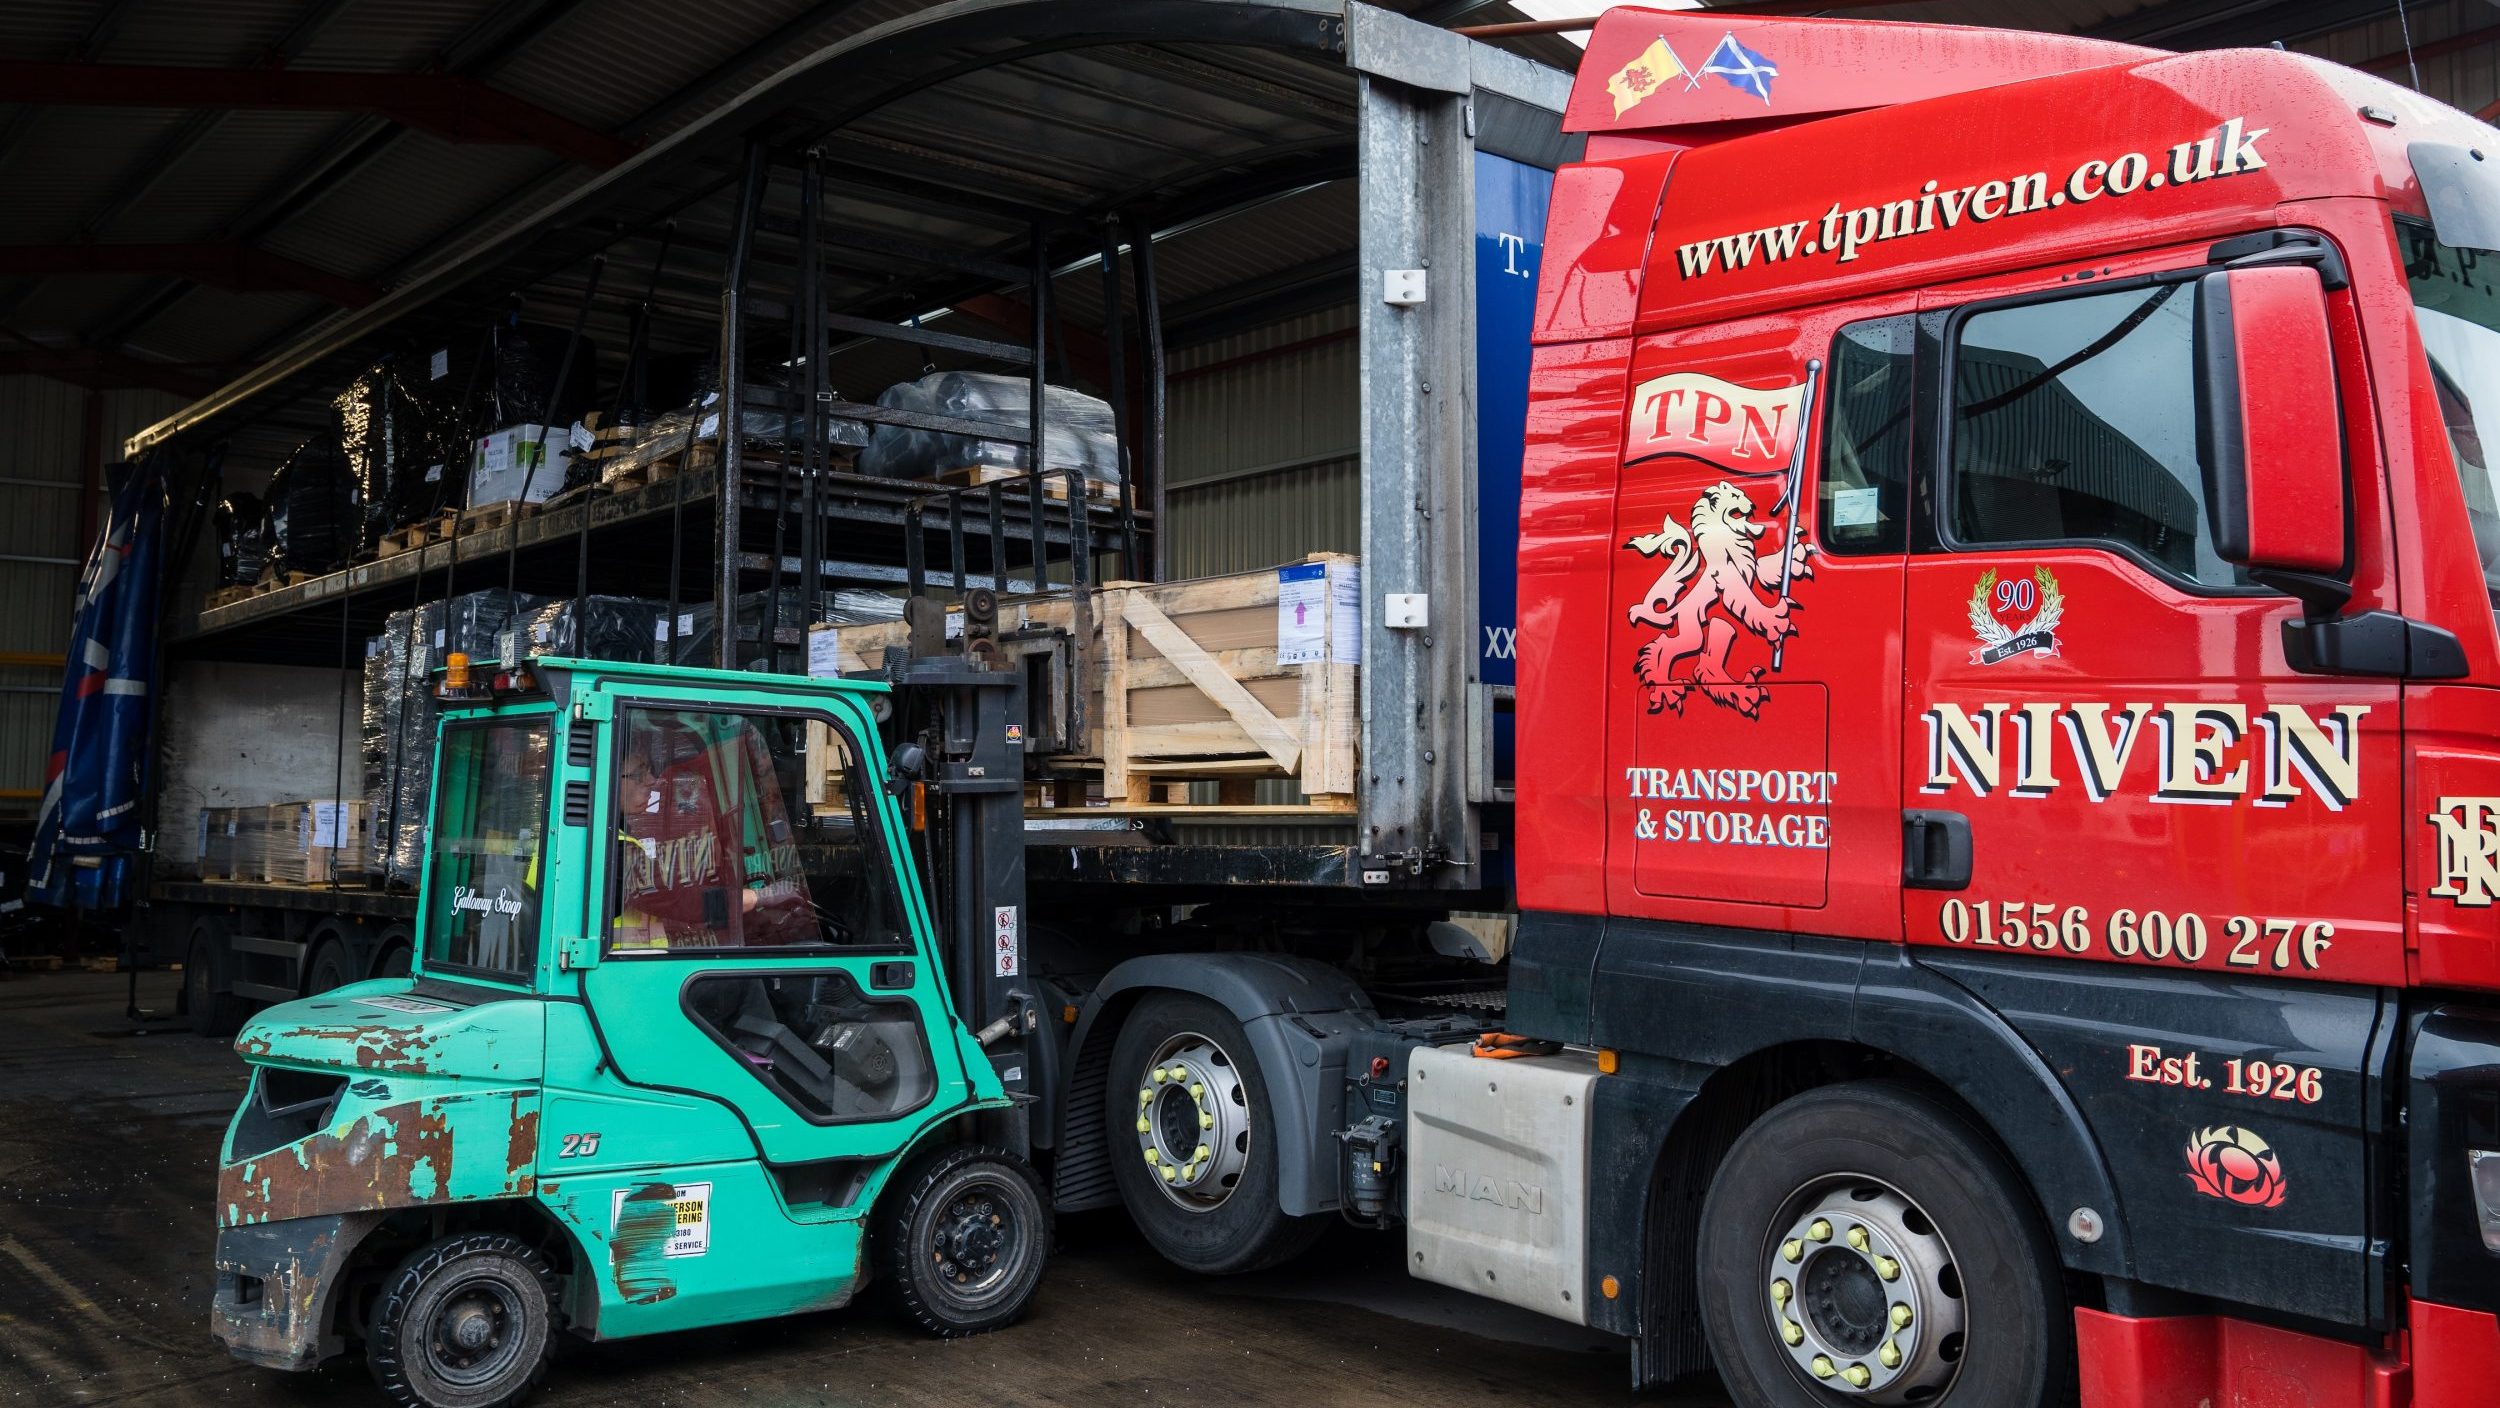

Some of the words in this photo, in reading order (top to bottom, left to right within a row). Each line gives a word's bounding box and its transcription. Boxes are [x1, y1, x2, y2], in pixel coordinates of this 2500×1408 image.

[1675, 117, 2269, 280] www.tpniven.co.uk
[1499, 232, 1529, 278] T.
[1644, 388, 1788, 460] TPN
[1997, 579, 2034, 612] 90
[1999, 612, 2032, 623] YEARS
[1997, 646, 2015, 658] Est.
[2015, 637, 2037, 651] 1926
[1919, 702, 2371, 812] NIVEN
[1626, 766, 1838, 806] TRANSPORT
[1635, 809, 1658, 841] &
[1664, 809, 1831, 849] STORAGE
[451, 886, 493, 918] Galloway
[494, 887, 522, 921] Scoop
[1939, 897, 2091, 953] 01556
[2108, 908, 2208, 963] 600
[2126, 1043, 2211, 1090] Est.
[2223, 1058, 2324, 1105] 1926
[558, 1132, 601, 1159] 25
[672, 1201, 704, 1213] ERSON
[1433, 1162, 1543, 1215] MAN
[677, 1212, 703, 1224] ERING
[674, 1241, 703, 1251] SERVICE
